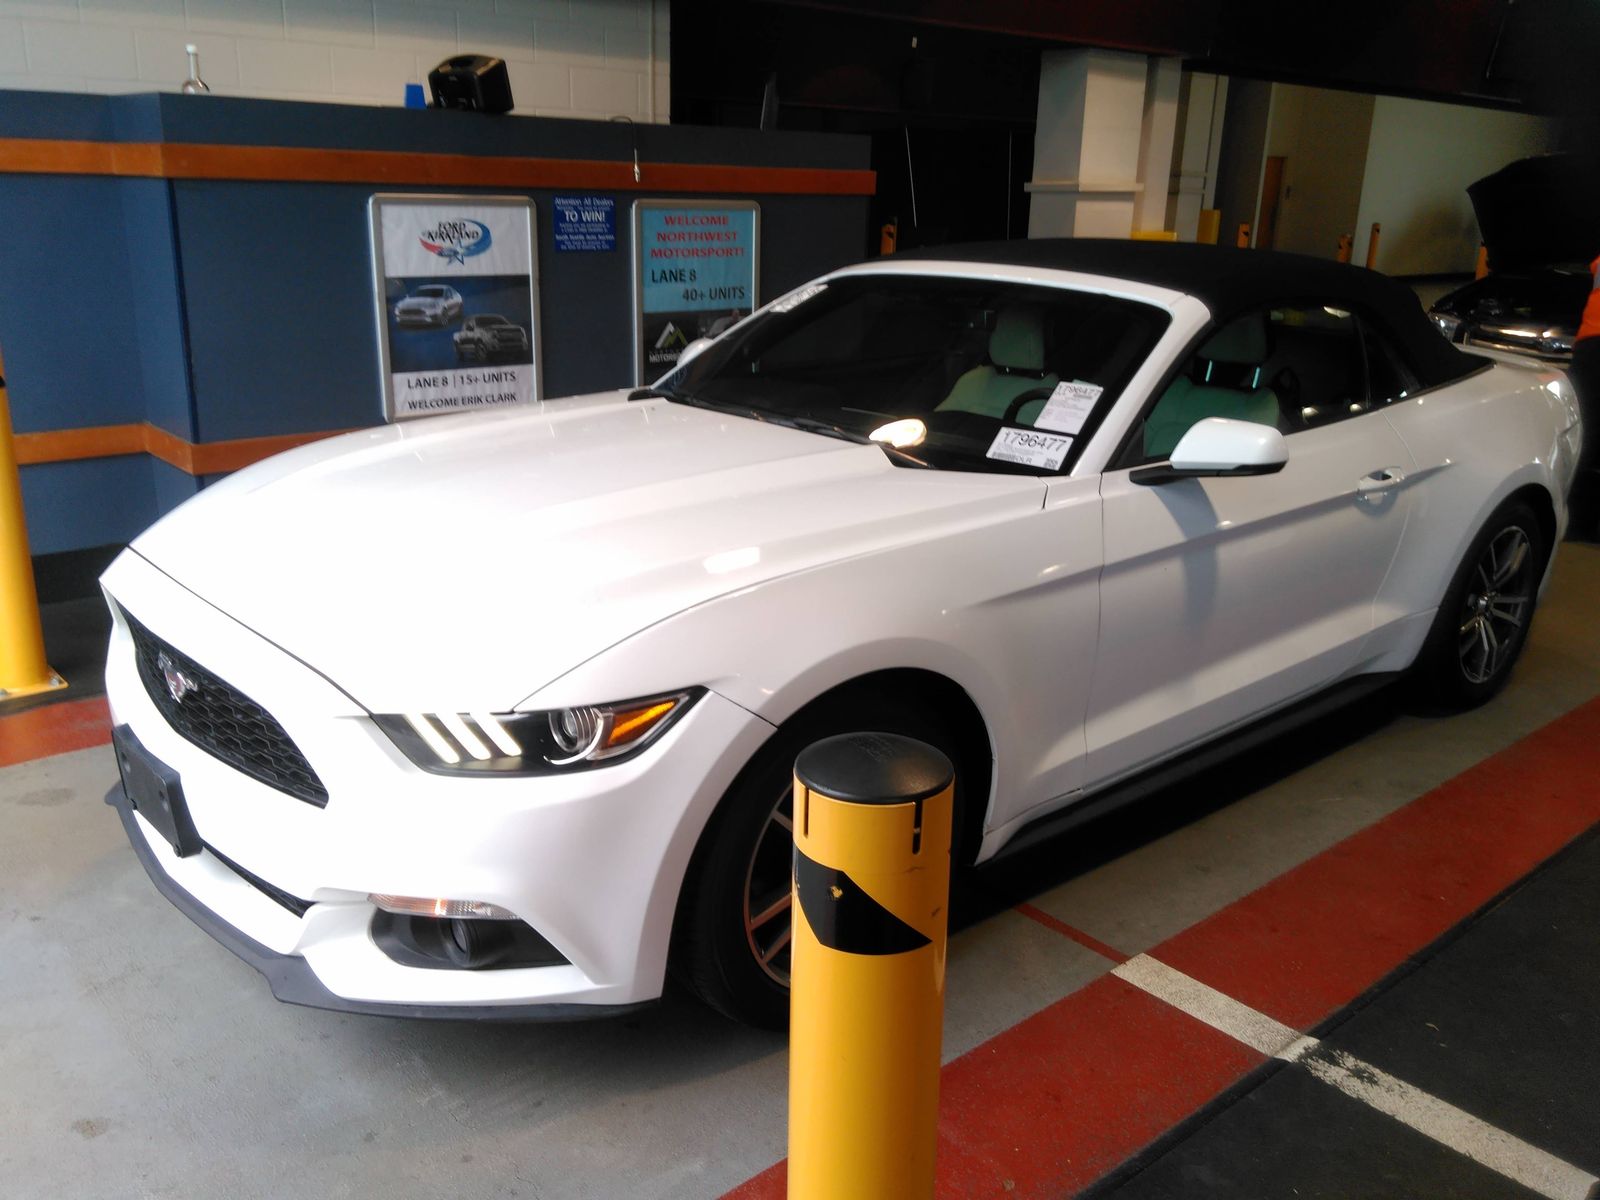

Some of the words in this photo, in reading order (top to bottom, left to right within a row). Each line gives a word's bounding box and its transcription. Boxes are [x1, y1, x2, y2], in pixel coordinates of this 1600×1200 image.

[564, 210, 578, 222] TO
[581, 210, 605, 222] WIN!
[664, 215, 729, 226] WELCOME
[656, 231, 737, 242] NORTHWEST
[650, 247, 744, 259] MOTORSPORT!
[651, 268, 686, 283] LANE
[689, 268, 697, 282] 8
[682, 288, 706, 302] 40+
[709, 286, 745, 300] UNITS
[407, 376, 439, 389] LANE
[441, 376, 449, 388] 8
[460, 374, 480, 386] 15+
[483, 371, 516, 384] UNITS
[408, 397, 459, 410] WELCOME
[462, 395, 483, 406] ERIK
[485, 392, 517, 404] CLARK
[1004, 431, 1067, 452] 1796477
